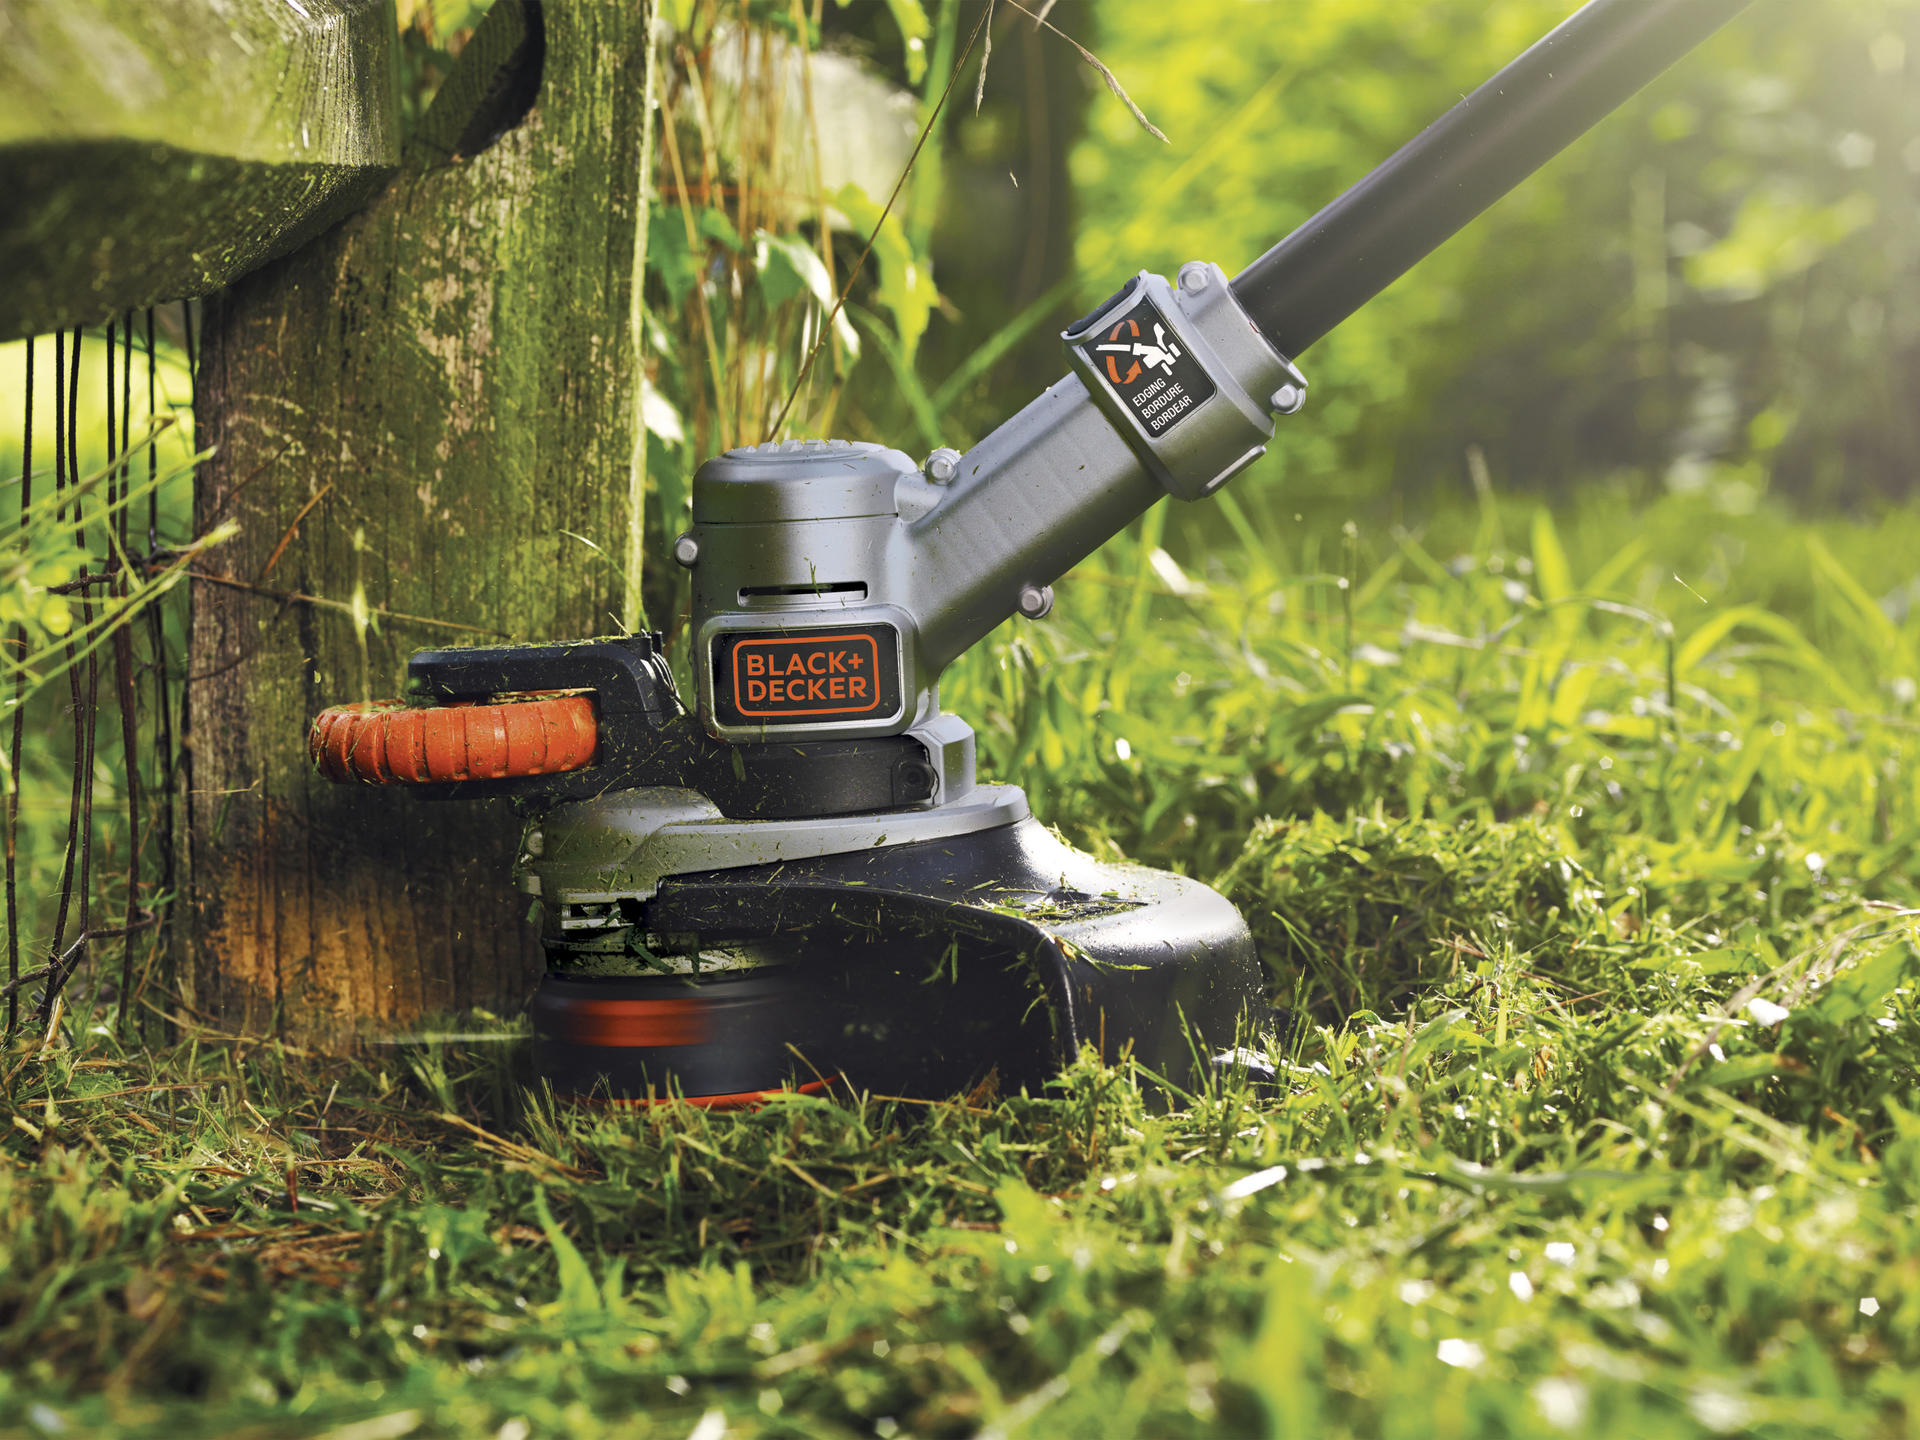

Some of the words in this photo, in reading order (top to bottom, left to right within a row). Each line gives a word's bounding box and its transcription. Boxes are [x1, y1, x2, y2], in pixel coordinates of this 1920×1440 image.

[1132, 377, 1167, 407] EDGING
[1141, 382, 1184, 419] BORDURE
[1151, 395, 1193, 431] BORDEAR
[746, 650, 864, 676] BLACK+
[747, 676, 868, 702] DECKER
